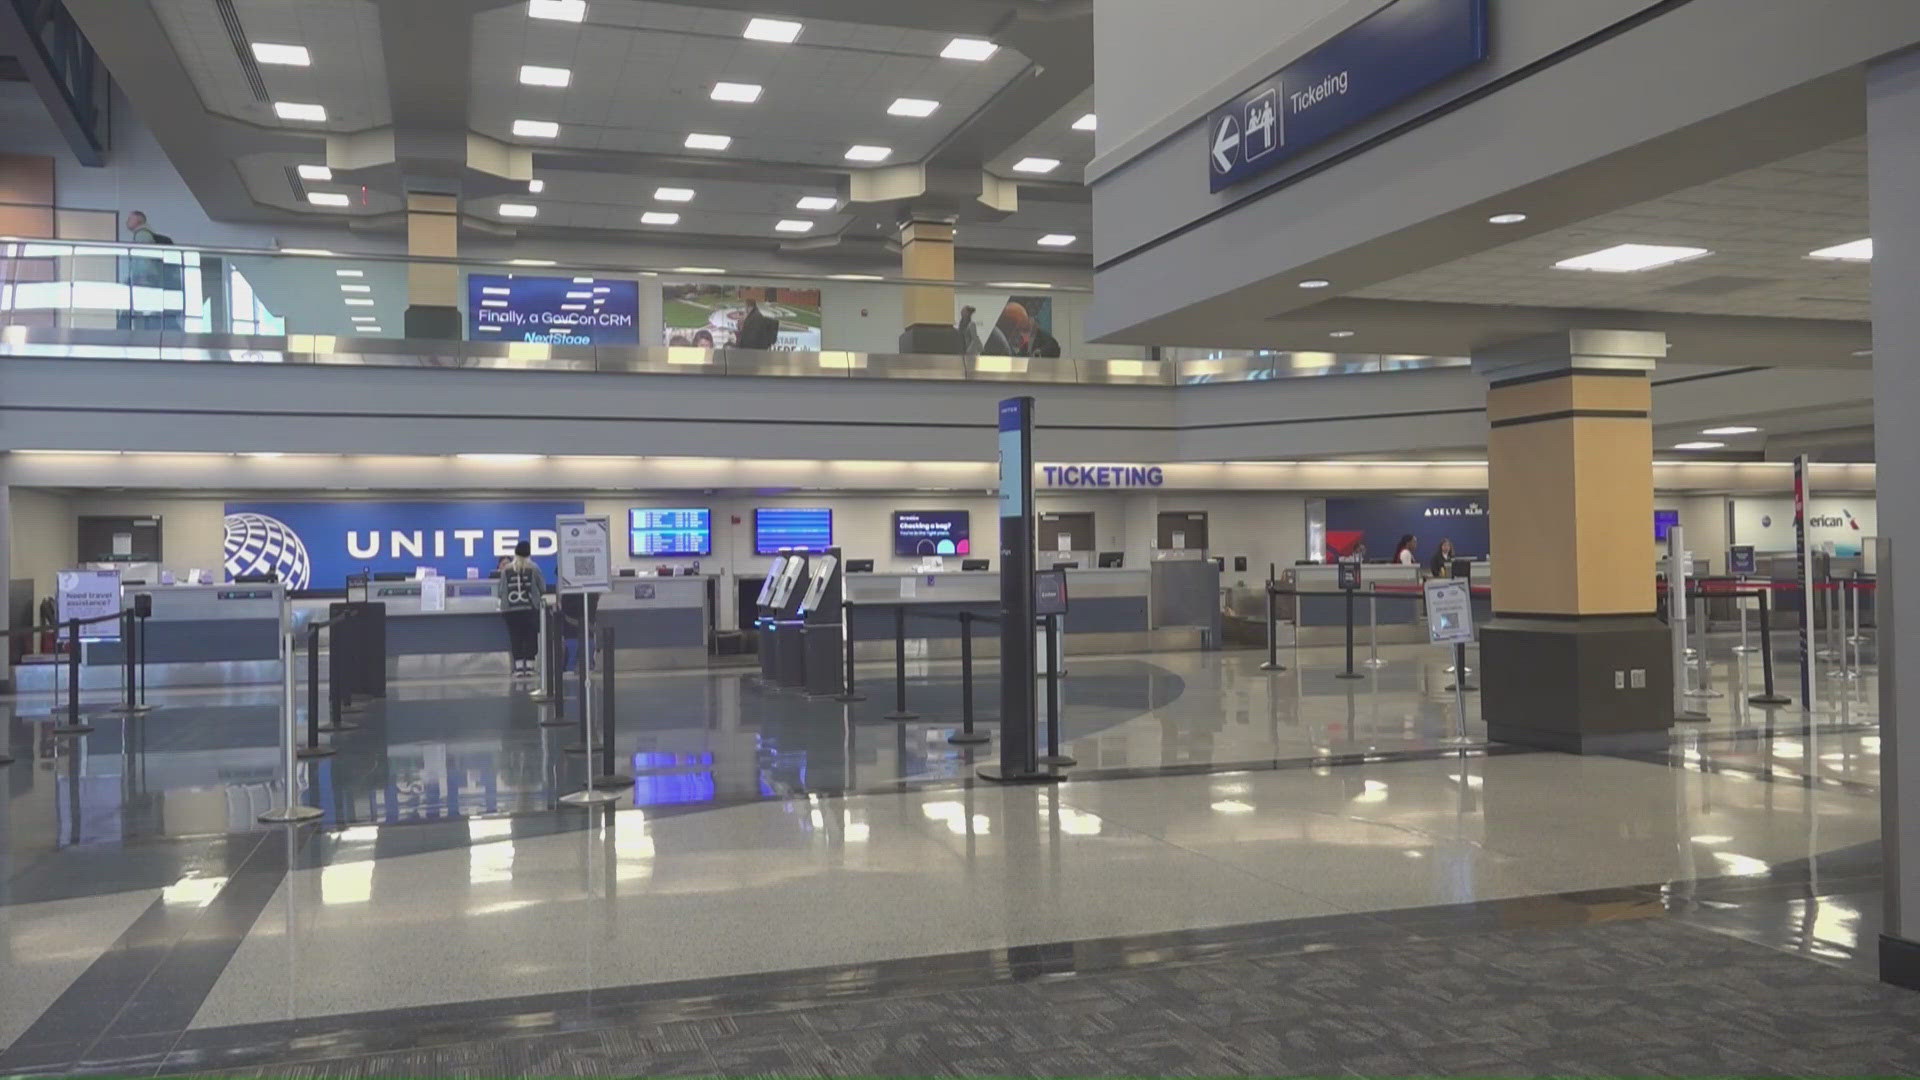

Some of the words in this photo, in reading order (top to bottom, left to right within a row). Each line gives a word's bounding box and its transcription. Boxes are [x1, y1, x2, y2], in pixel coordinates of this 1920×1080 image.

[1290, 70, 1348, 114] Ticketing
[478, 309, 527, 325] Finally,
[529, 315, 539, 323] a
[542, 313, 596, 325] GovCon
[599, 314, 632, 327] CRM
[524, 332, 591, 345] NextStage
[1043, 466, 1164, 486] TICKETING
[1433, 508, 1461, 516] DELTA
[900, 522, 929, 530] Checking
[936, 522, 951, 530] bag?
[347, 528, 558, 559] UNITED
